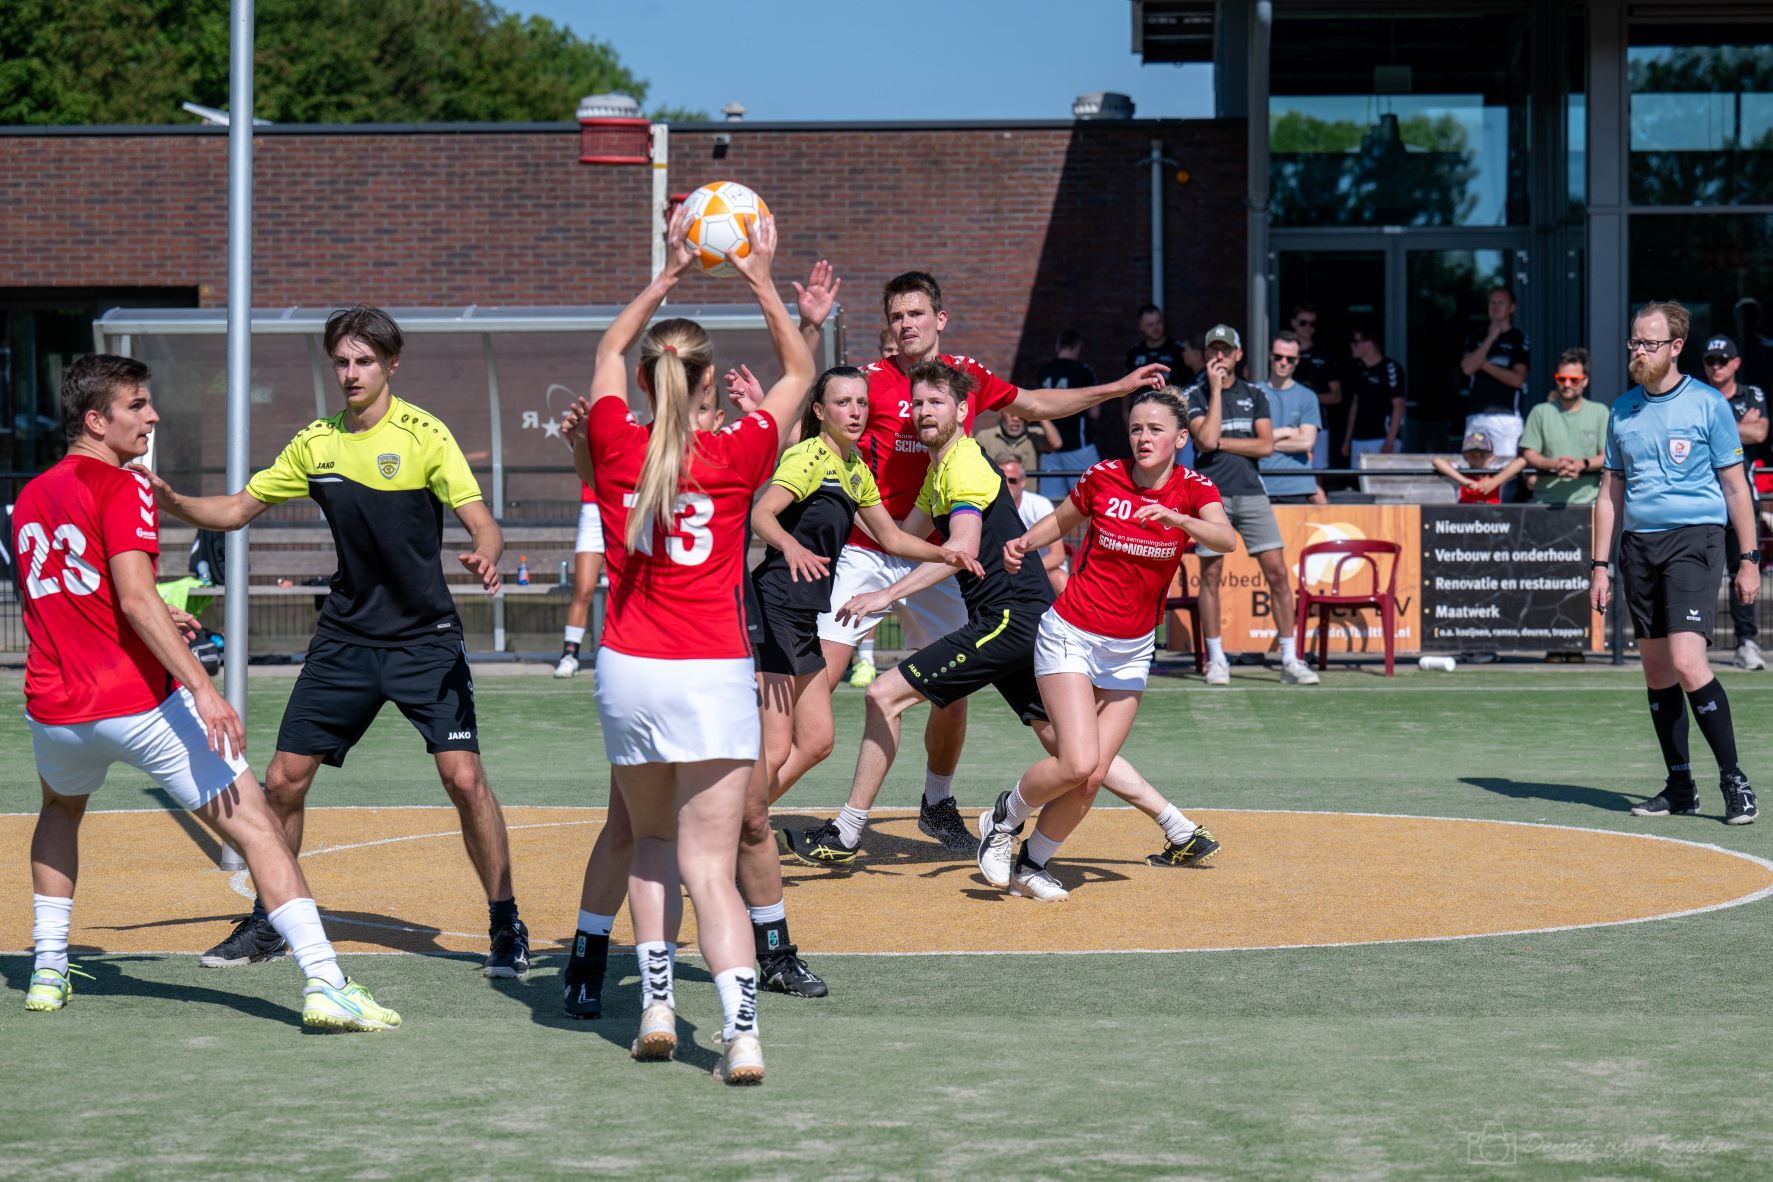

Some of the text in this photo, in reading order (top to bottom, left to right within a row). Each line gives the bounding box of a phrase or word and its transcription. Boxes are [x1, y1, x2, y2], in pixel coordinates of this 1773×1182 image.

[316, 461, 335, 469] JAKO
[1104, 497, 1132, 520] 20
[1435, 520, 1510, 534] Nieuwbouw
[18, 522, 101, 599] 23
[1434, 547, 1582, 562] Verbouw en onderhoud
[1435, 576, 1590, 590] Renovatie en restauratie
[1435, 604, 1501, 618] Maatwerk
[447, 731, 471, 740] JAKO
